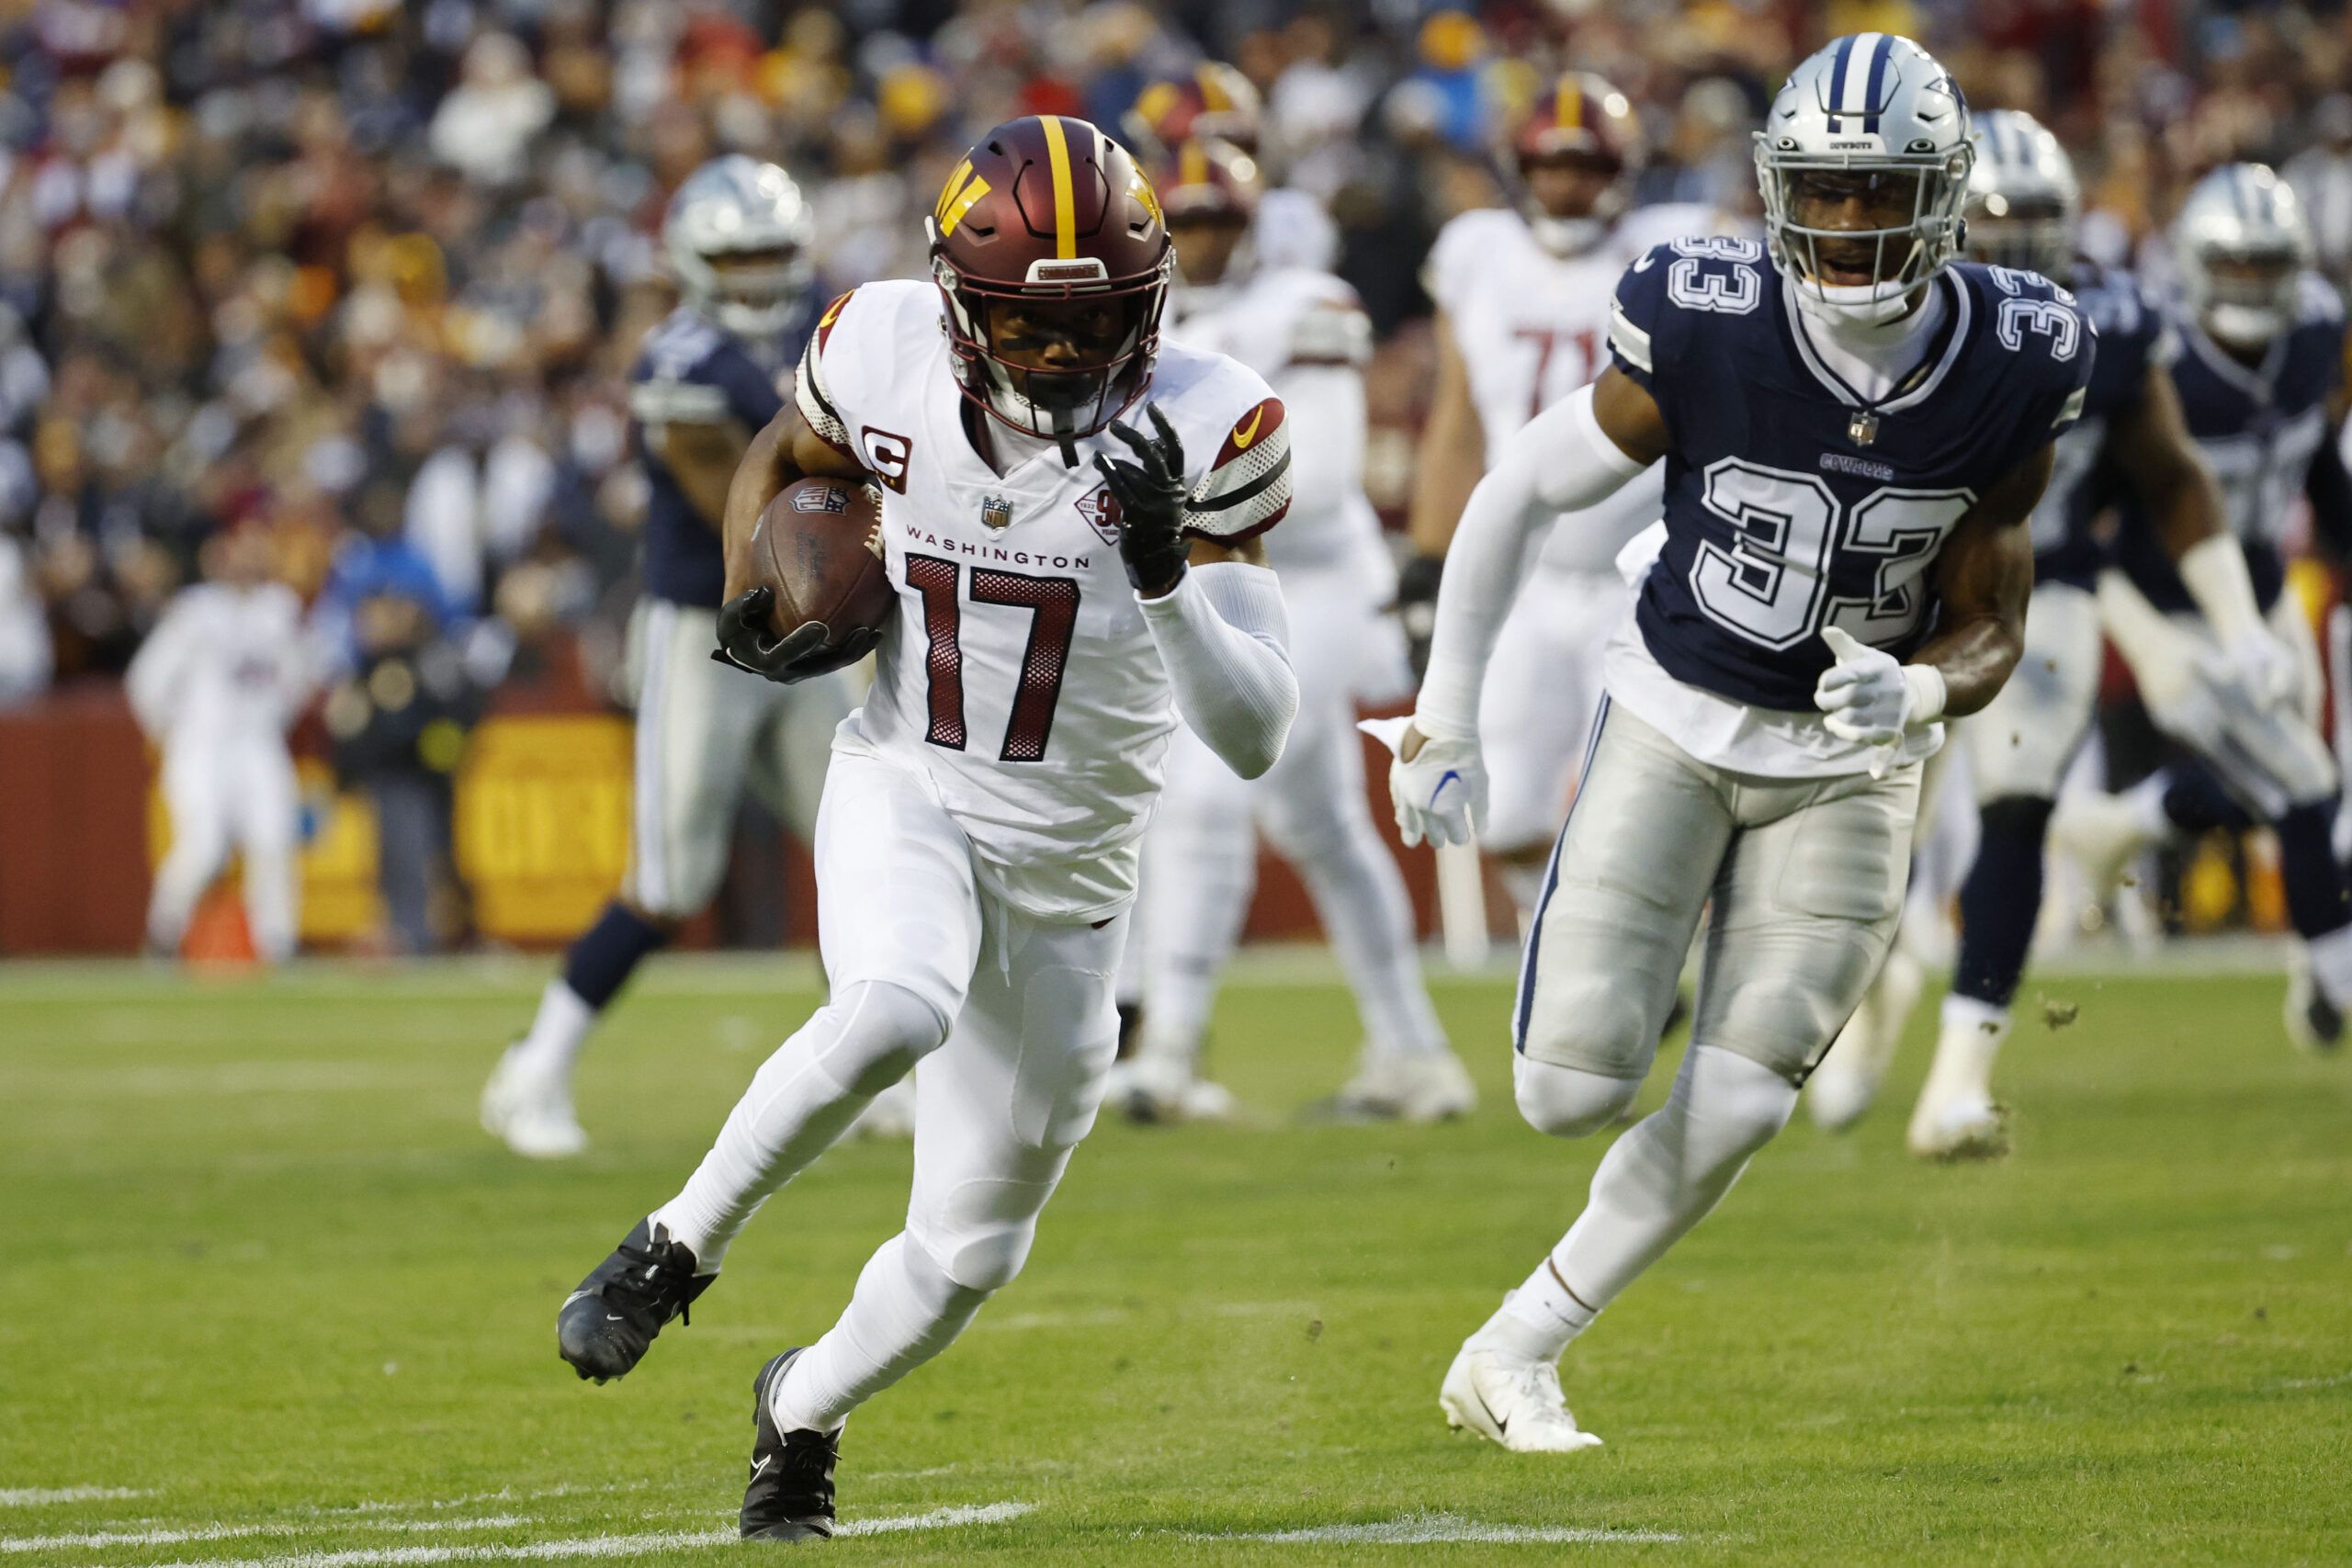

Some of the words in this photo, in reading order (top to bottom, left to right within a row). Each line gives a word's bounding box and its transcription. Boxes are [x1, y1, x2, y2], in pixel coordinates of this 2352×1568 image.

[1512, 327, 1597, 419] 71
[864, 432, 906, 478] C
[907, 525, 1090, 568] WASHINGTON
[1689, 456, 1978, 651] 33
[905, 552, 1081, 761] 17
